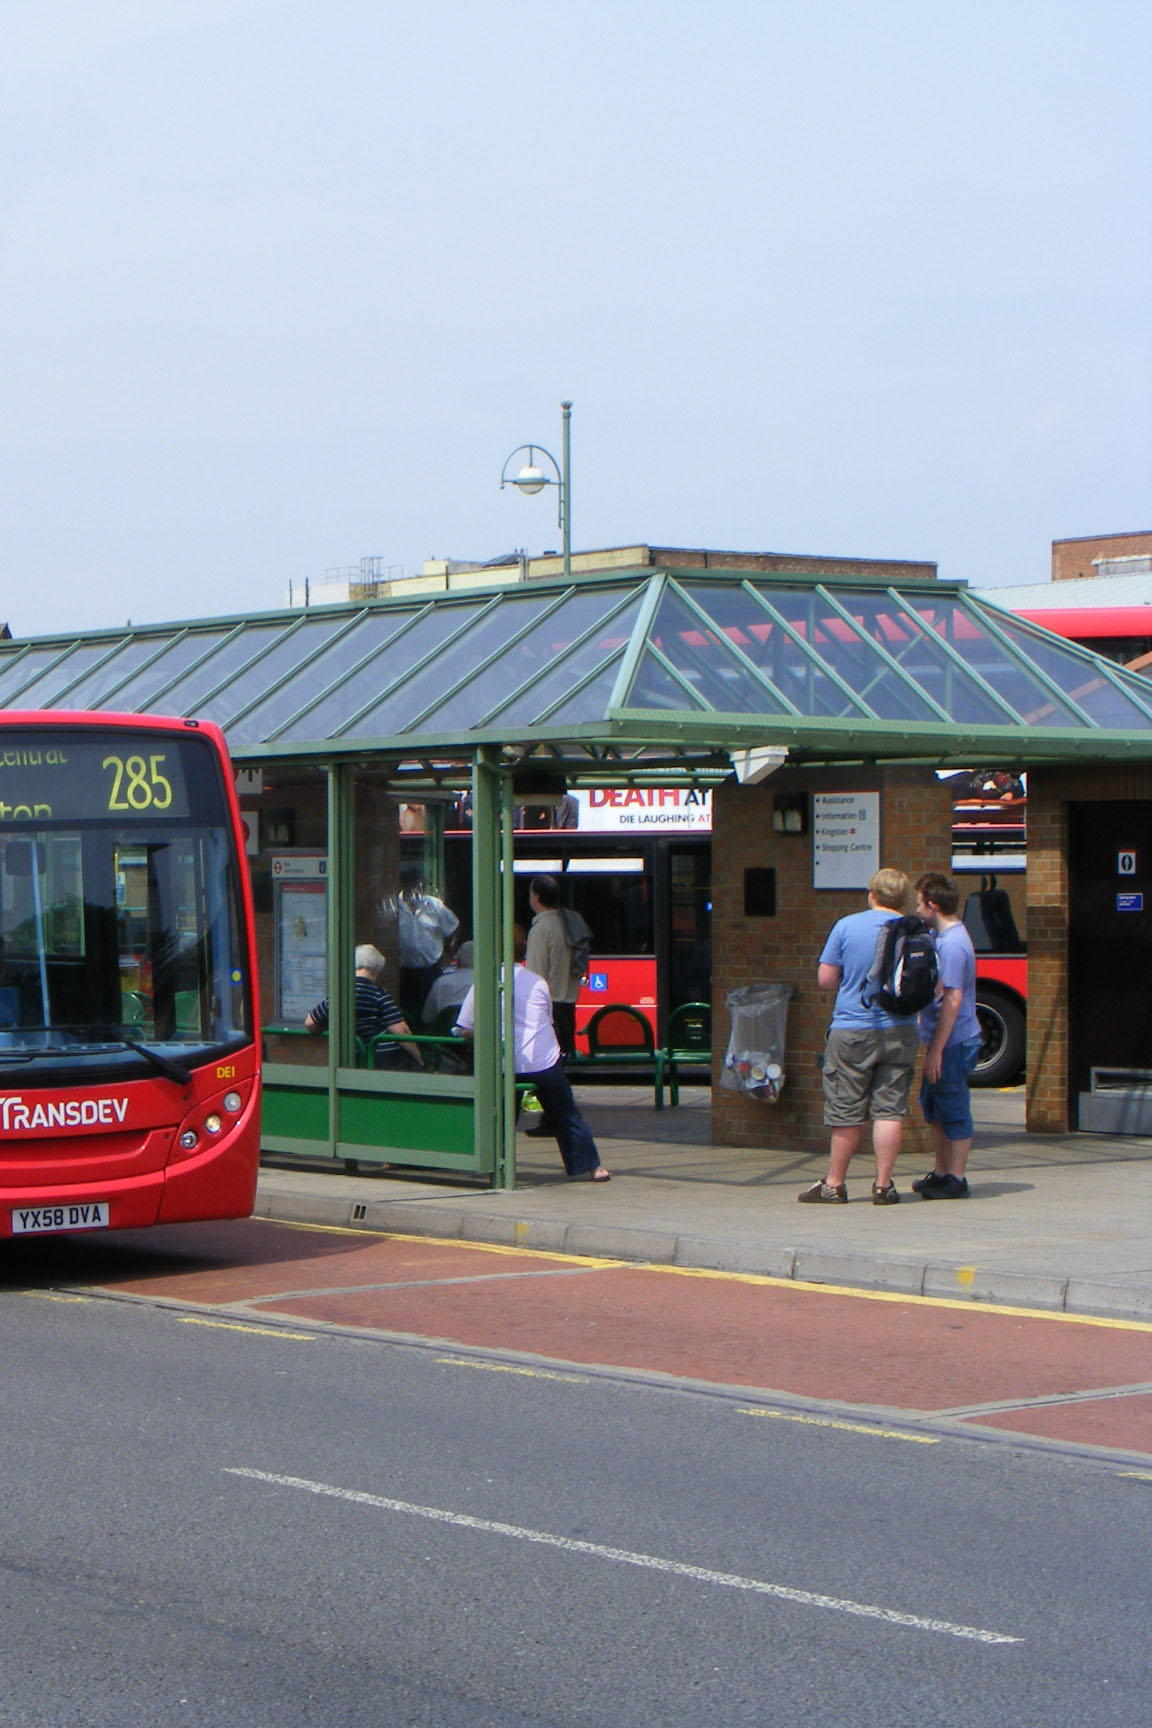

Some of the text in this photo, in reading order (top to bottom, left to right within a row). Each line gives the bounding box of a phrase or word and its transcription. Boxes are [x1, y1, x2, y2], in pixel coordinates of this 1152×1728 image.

[102, 754, 173, 811] 285
[589, 788, 680, 808] DEATH
[822, 796, 855, 805] Assistance
[619, 813, 711, 824] DIE LAUGHING AT
[822, 811, 858, 820] Information
[822, 827, 848, 838] Kingston
[822, 843, 873, 854] Shopping Centre
[19, 1205, 102, 1229] YX58 DVA
